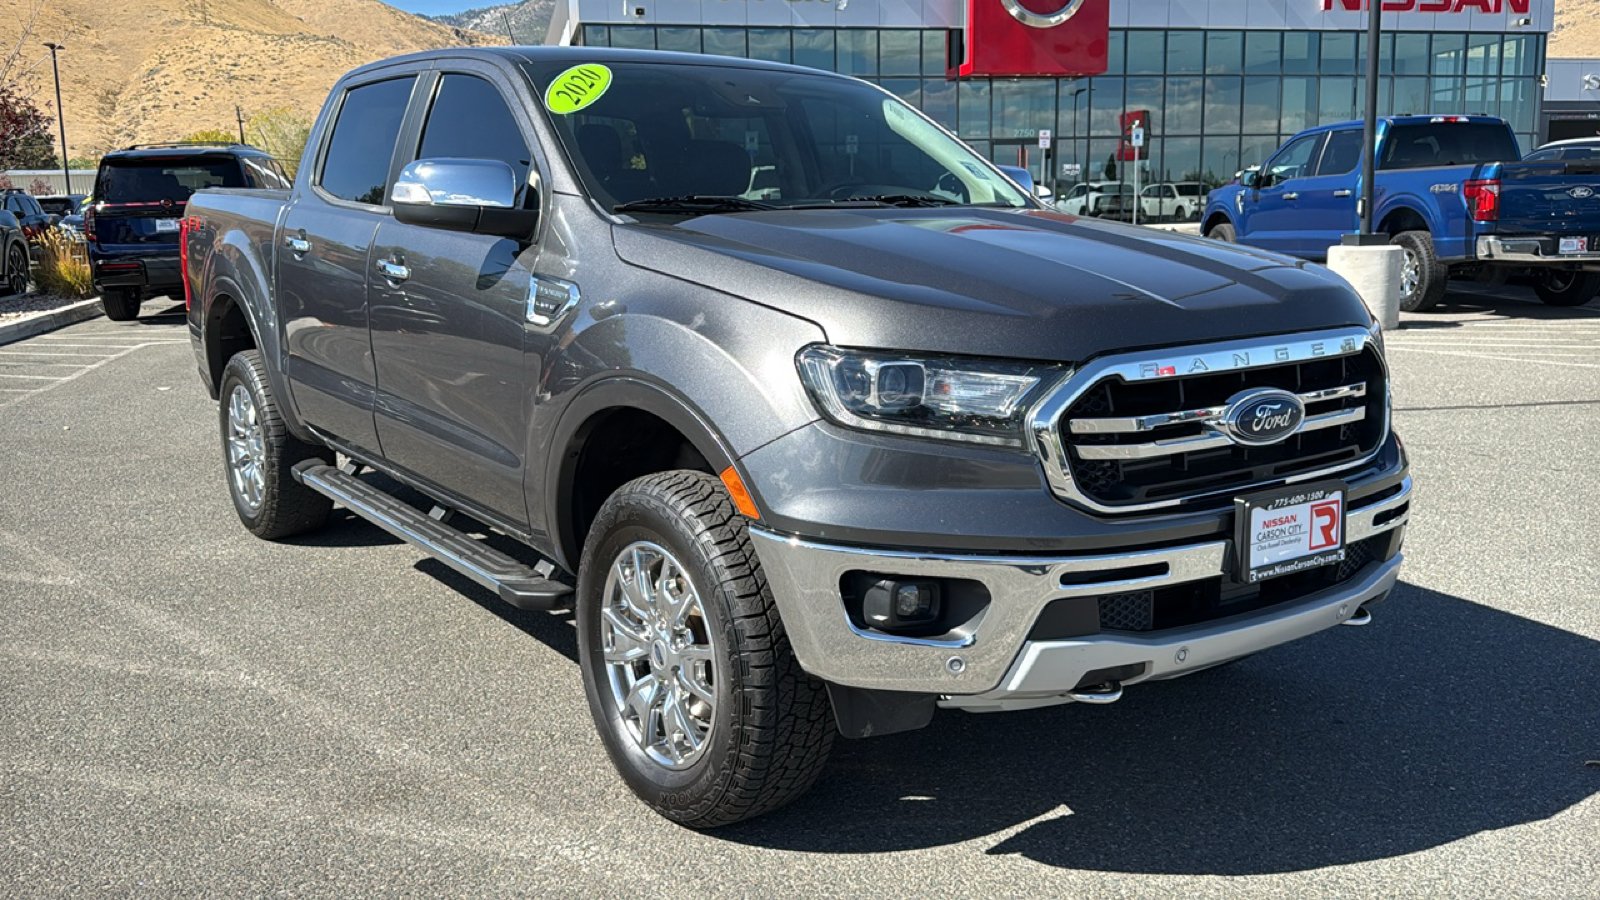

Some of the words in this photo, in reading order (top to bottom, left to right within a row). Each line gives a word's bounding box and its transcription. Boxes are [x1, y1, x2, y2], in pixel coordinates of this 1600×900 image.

[555, 68, 602, 106] 2020
[1013, 129, 1035, 138] 2750
[1572, 187, 1591, 198] Ford
[1139, 337, 1357, 378] RANGER
[1252, 403, 1292, 432] Ford
[1274, 490, 1324, 507] 775-600-1500
[1262, 514, 1297, 530] NISSAN
[1256, 528, 1286, 542] CARSON
[1288, 523, 1303, 536] CITY
[1258, 555, 1337, 578] www.NissanCarsonCity.com
